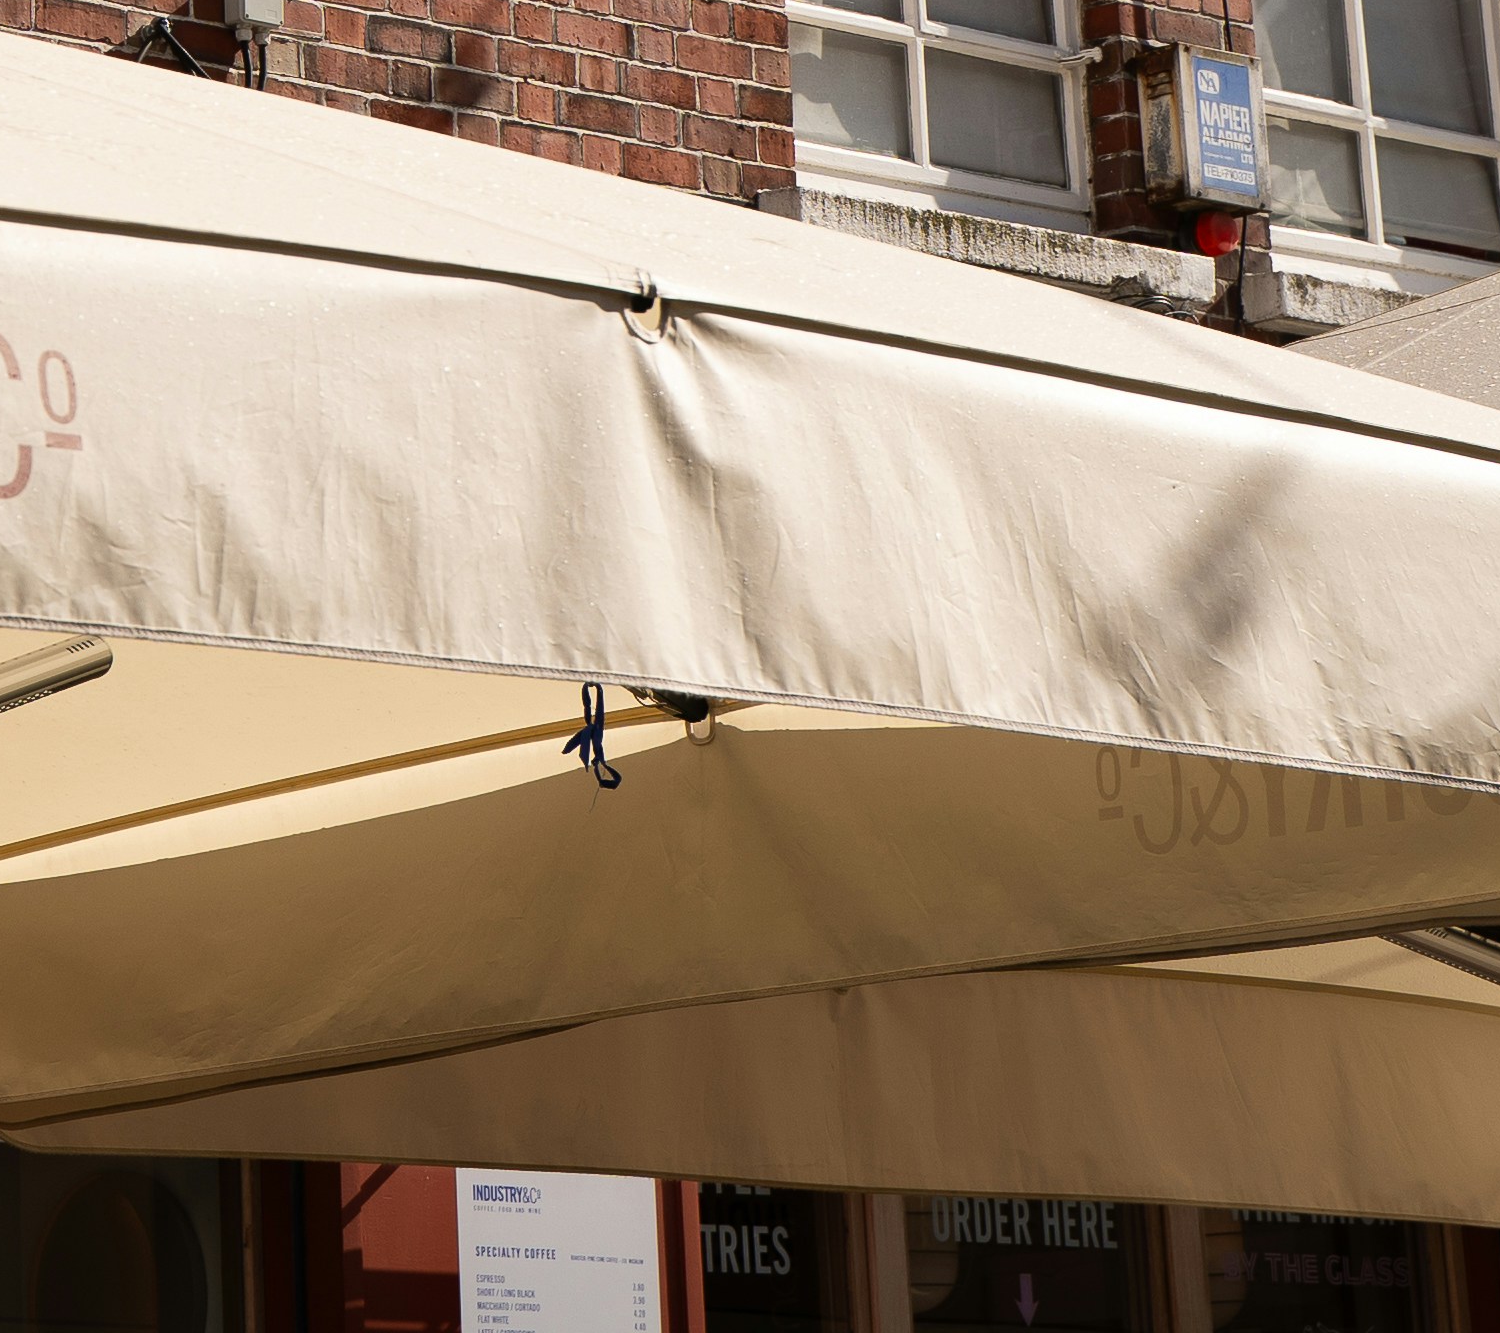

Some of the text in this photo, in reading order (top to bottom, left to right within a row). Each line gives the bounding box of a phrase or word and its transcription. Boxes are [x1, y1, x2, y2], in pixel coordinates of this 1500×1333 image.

[1199, 99, 1251, 133] NAPIER
[1203, 127, 1253, 151] ALARMS
[931, 1196, 1119, 1249] ORDER HERE
[475, 1246, 520, 1259] SPECIALTY
[524, 1248, 556, 1260] COFFEE
[1264, 1252, 1320, 1284] THE
[1324, 1254, 1411, 1288] GLASS
[476, 1274, 505, 1284] ESPRESSO
[476, 1288, 496, 1298] SHORT
[500, 1289, 516, 1298] LONG
[517, 1289, 535, 1299] BLACK
[477, 1301, 510, 1311] MACCHIATO
[514, 1303, 541, 1312] CORTADO
[477, 1315, 490, 1324] FLAT
